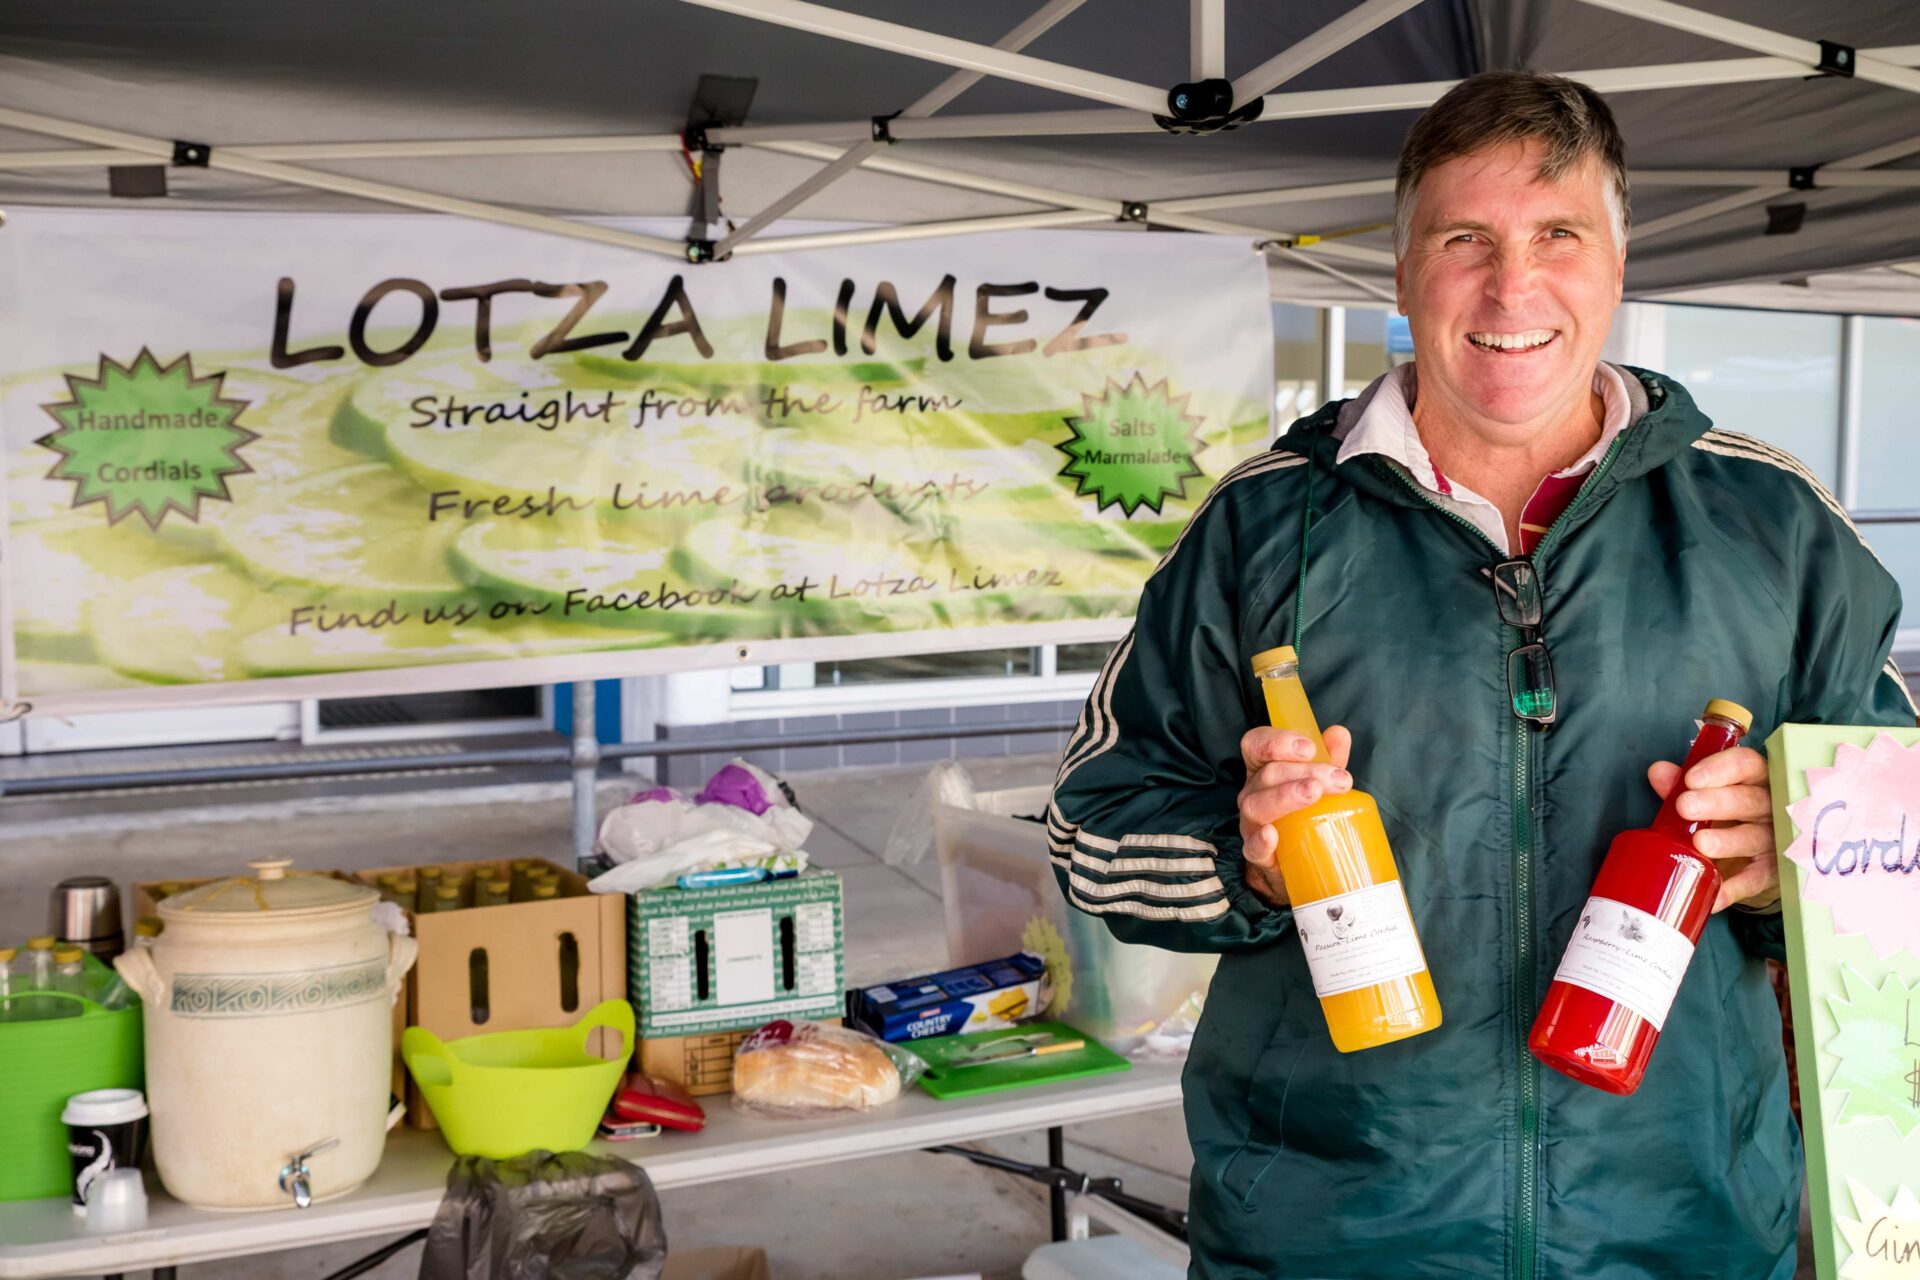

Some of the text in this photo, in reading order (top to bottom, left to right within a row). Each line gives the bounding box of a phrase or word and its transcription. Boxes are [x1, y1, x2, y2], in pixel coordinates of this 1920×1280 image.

[269, 273, 1129, 369] LOTZA LIMEZ
[77, 408, 221, 432] Handmade
[409, 385, 964, 431] Straight from the farm
[1108, 417, 1158, 438] Salts
[1083, 446, 1184, 467] Marmalade
[98, 459, 203, 484] Cordials
[428, 485, 595, 522] Fresh
[611, 481, 745, 511] lime
[289, 568, 1065, 636] Find us on Facebook at Lotza Limez
[1812, 799, 1920, 877] Cord
[906, 1013, 953, 1033] COUNTRY
[911, 1023, 948, 1039] CHEESE
